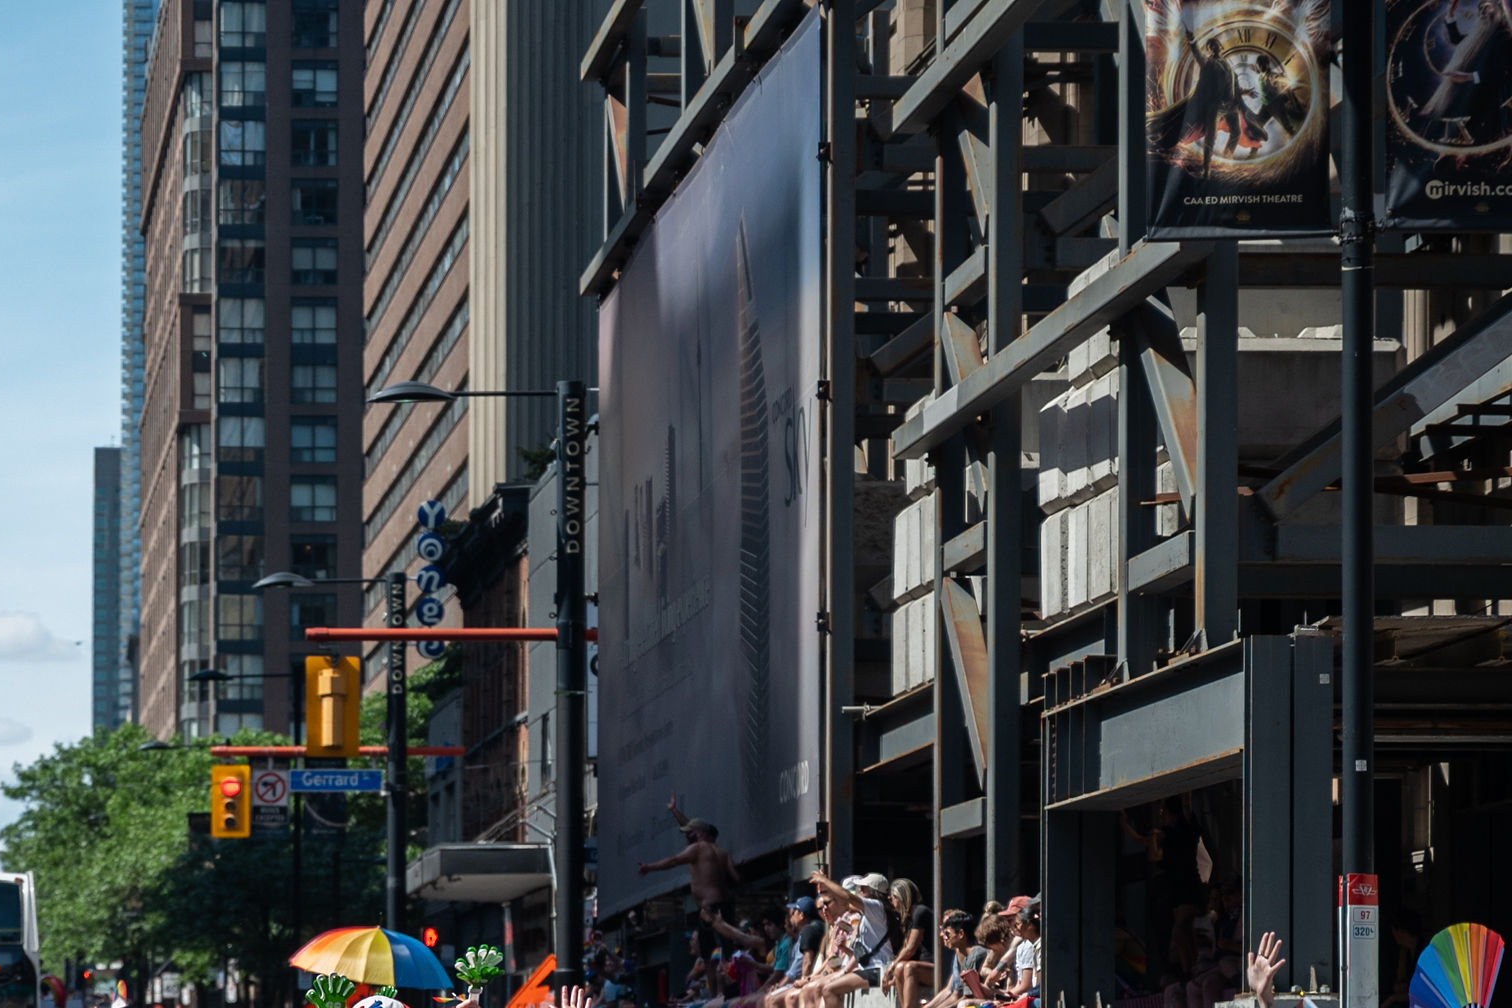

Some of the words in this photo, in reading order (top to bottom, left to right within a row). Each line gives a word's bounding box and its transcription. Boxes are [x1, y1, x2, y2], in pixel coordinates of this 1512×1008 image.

[1184, 196, 1204, 206] CAA
[1205, 196, 1218, 205] ED
[1219, 194, 1259, 205] MIRVISH
[1261, 194, 1303, 204] THEATRE
[566, 397, 581, 554] DOWNTOWN
[392, 583, 404, 695] DOWNOWN
[301, 772, 359, 787] Gerrard
[1360, 910, 1371, 920] 97
